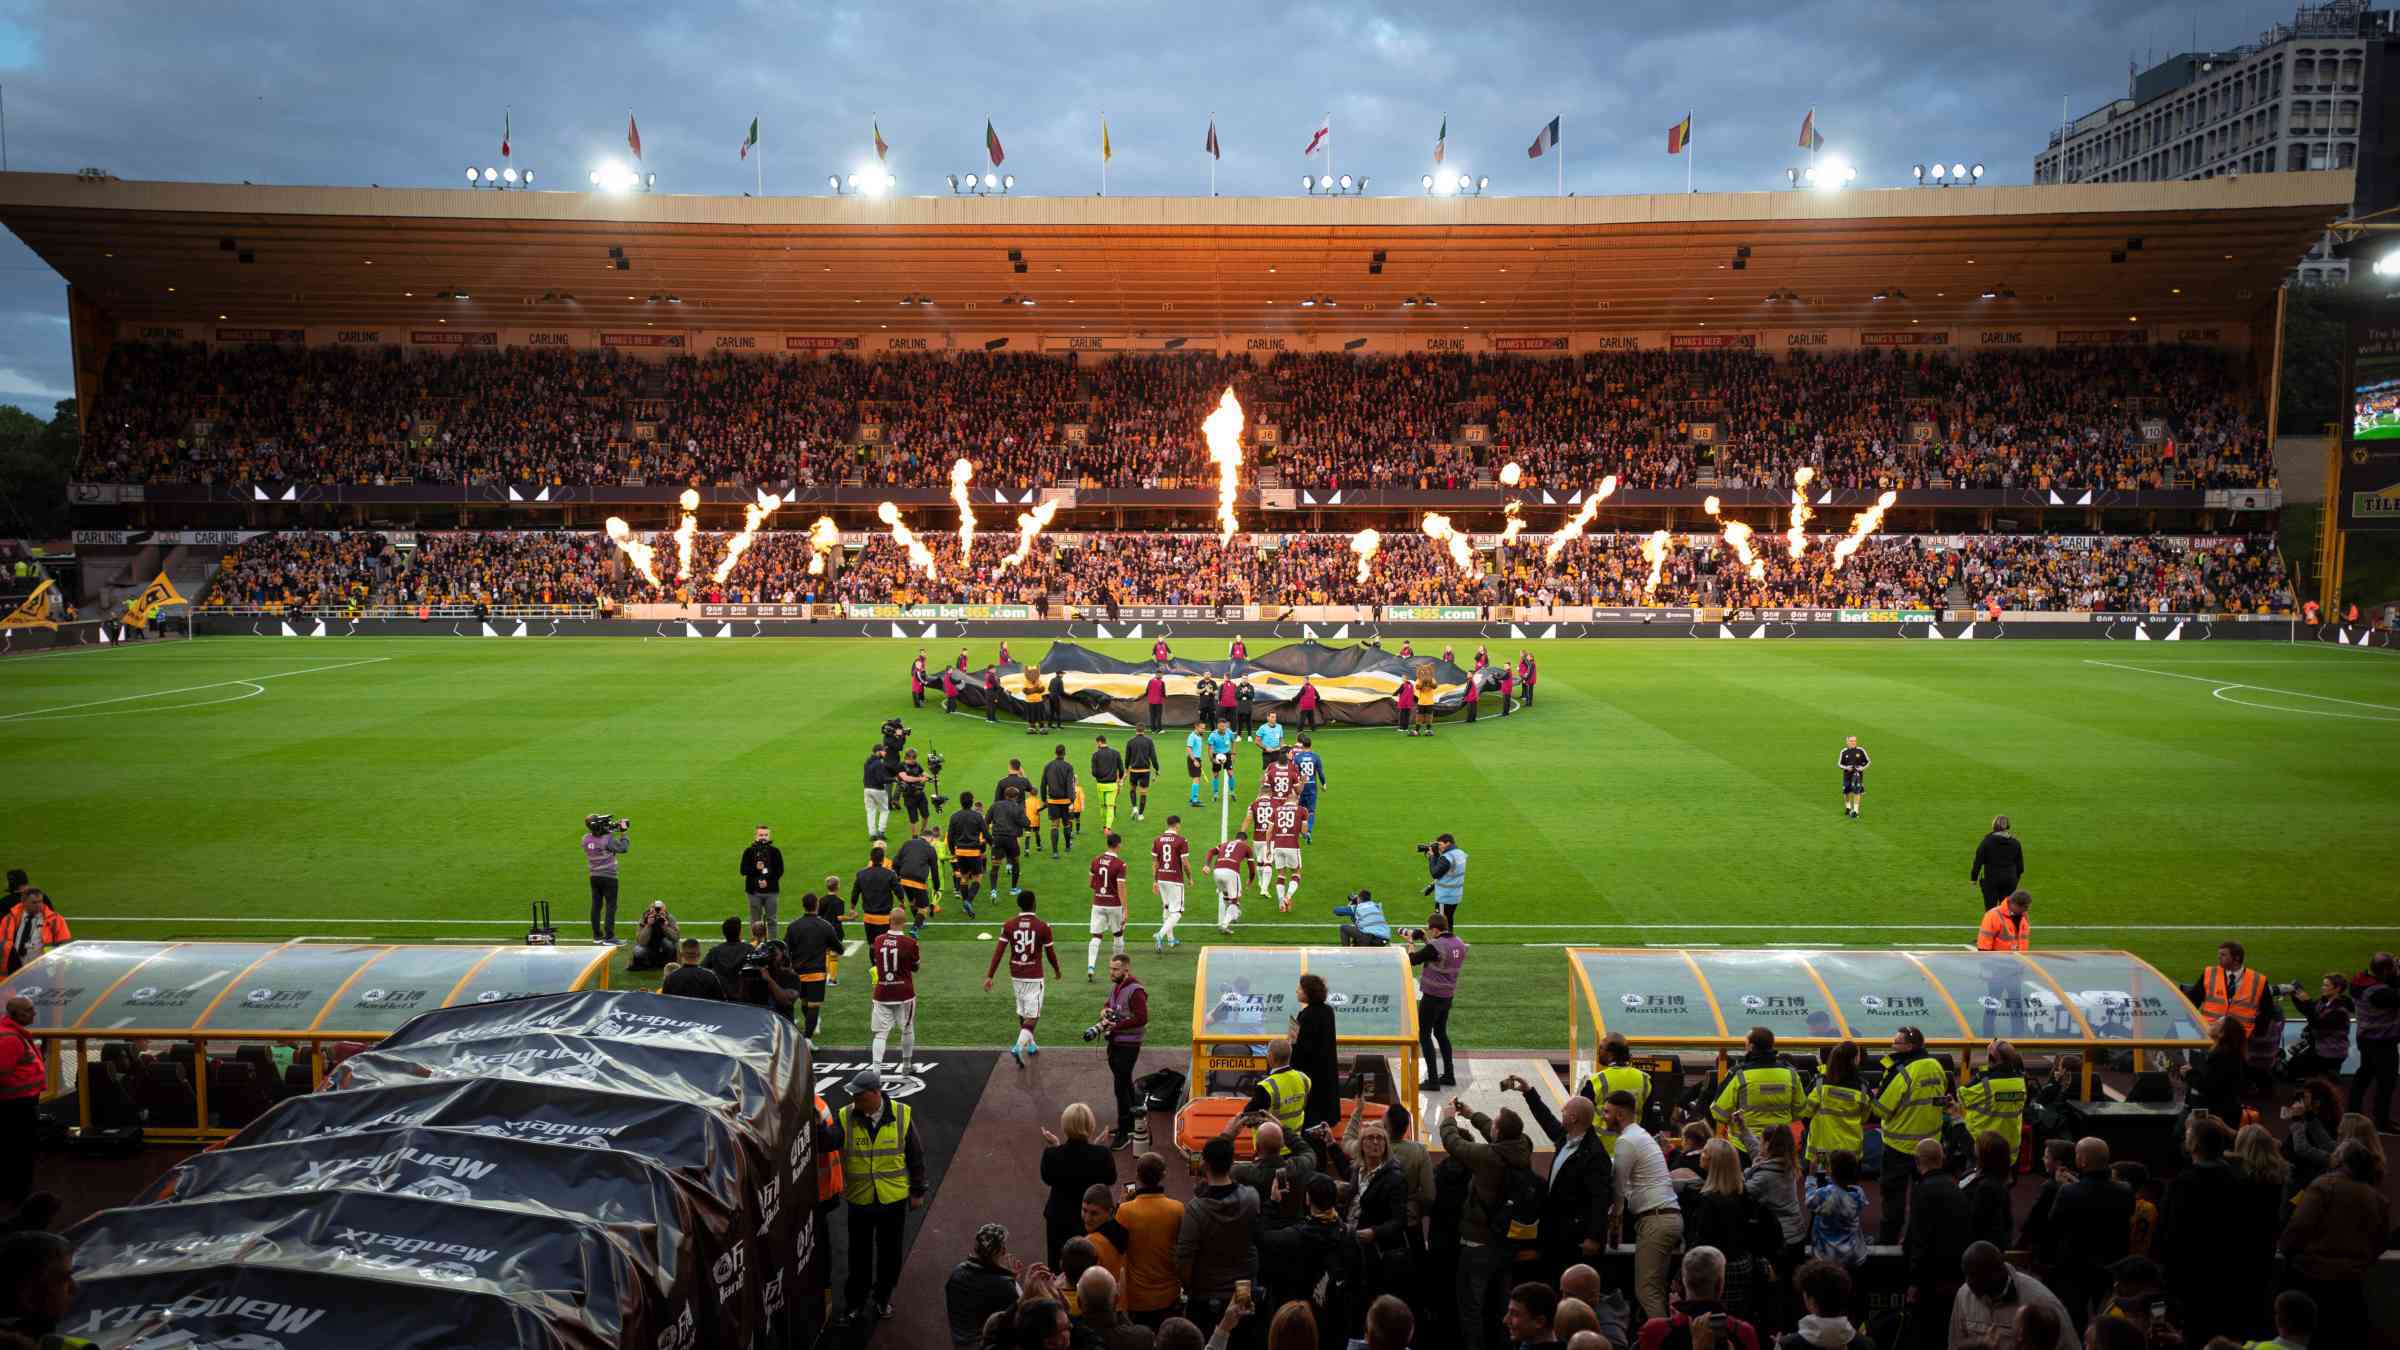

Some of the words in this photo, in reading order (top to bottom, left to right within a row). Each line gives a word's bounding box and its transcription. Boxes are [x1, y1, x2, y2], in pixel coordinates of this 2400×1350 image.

[529, 333, 568, 344] CARLING
[716, 337, 755, 348] CARLING
[1788, 334, 1828, 345] CARLING
[1981, 332, 2023, 343] CARLING
[888, 339, 927, 349] CARLING
[1247, 339, 1285, 349] CARLING
[1427, 339, 1465, 349] CARLING
[1600, 338, 1638, 349] CARLING
[77, 532, 122, 544] CARLING
[195, 532, 239, 544] CARLING
[940, 606, 1026, 618] bet365.com
[1389, 608, 1476, 619] bet365.com
[1278, 811, 1295, 828] 29
[1163, 843, 1172, 863] 8
[1099, 866, 1108, 888] 7
[1013, 929, 1036, 954] 34
[880, 947, 898, 972] 11
[1351, 993, 1390, 1004] 万博
[1647, 994, 1685, 1006] 万博
[1767, 996, 1805, 1007] 万博
[1887, 996, 1925, 1008] 万博
[1625, 1006, 1689, 1015] ManBetX
[1746, 1008, 1809, 1016] ManBetX
[1866, 1008, 1930, 1017] ManBetX
[608, 1009, 722, 1032] ManBetX
[1209, 1058, 1255, 1069] OFFICIALS
[334, 1228, 499, 1263] ManBetX
